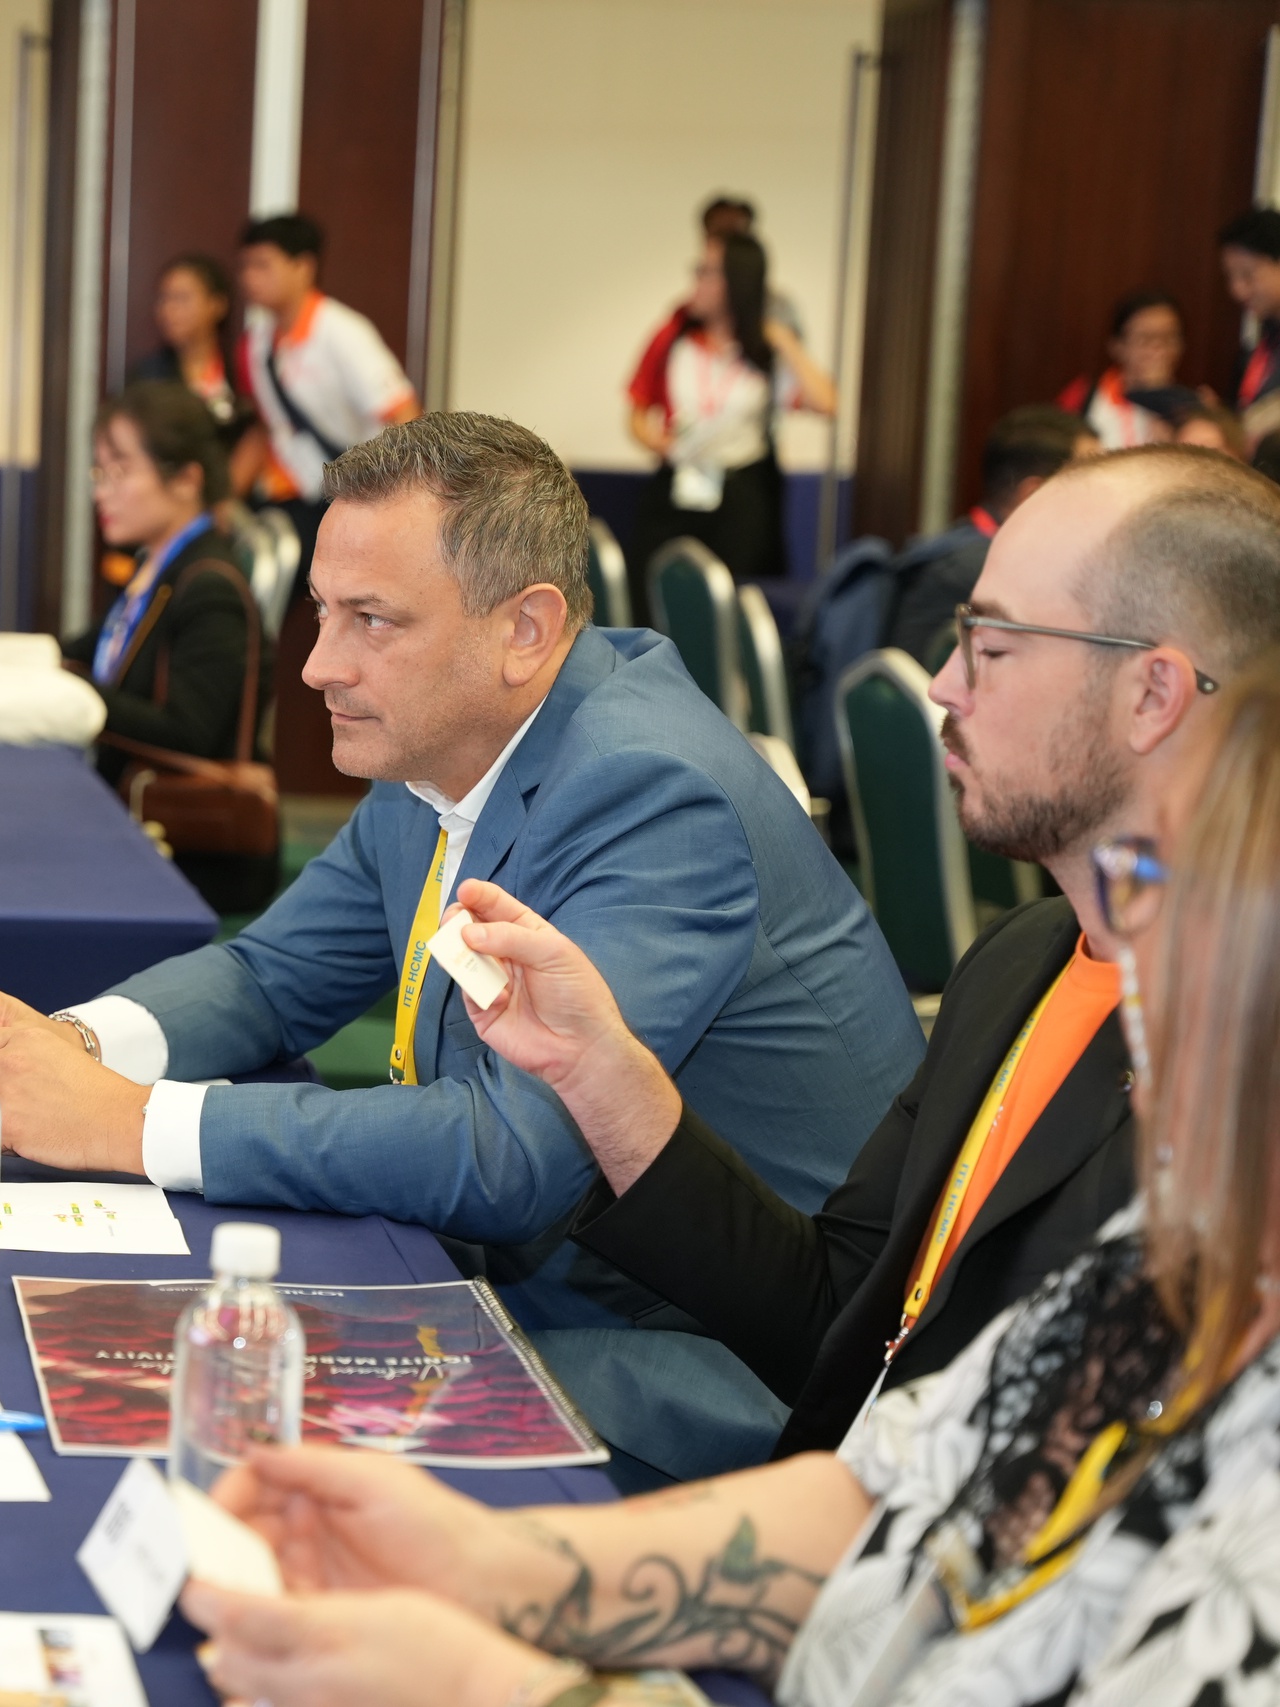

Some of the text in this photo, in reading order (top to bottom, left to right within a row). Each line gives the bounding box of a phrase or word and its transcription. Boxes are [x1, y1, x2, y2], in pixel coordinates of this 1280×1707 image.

[403, 940, 427, 1007] ITE HCMC
[936, 1163, 969, 1243] ITE HCMC
[94, 1350, 472, 1366] IGNITE MARK TIVITY
[329, 1363, 444, 1381] Vietnam
